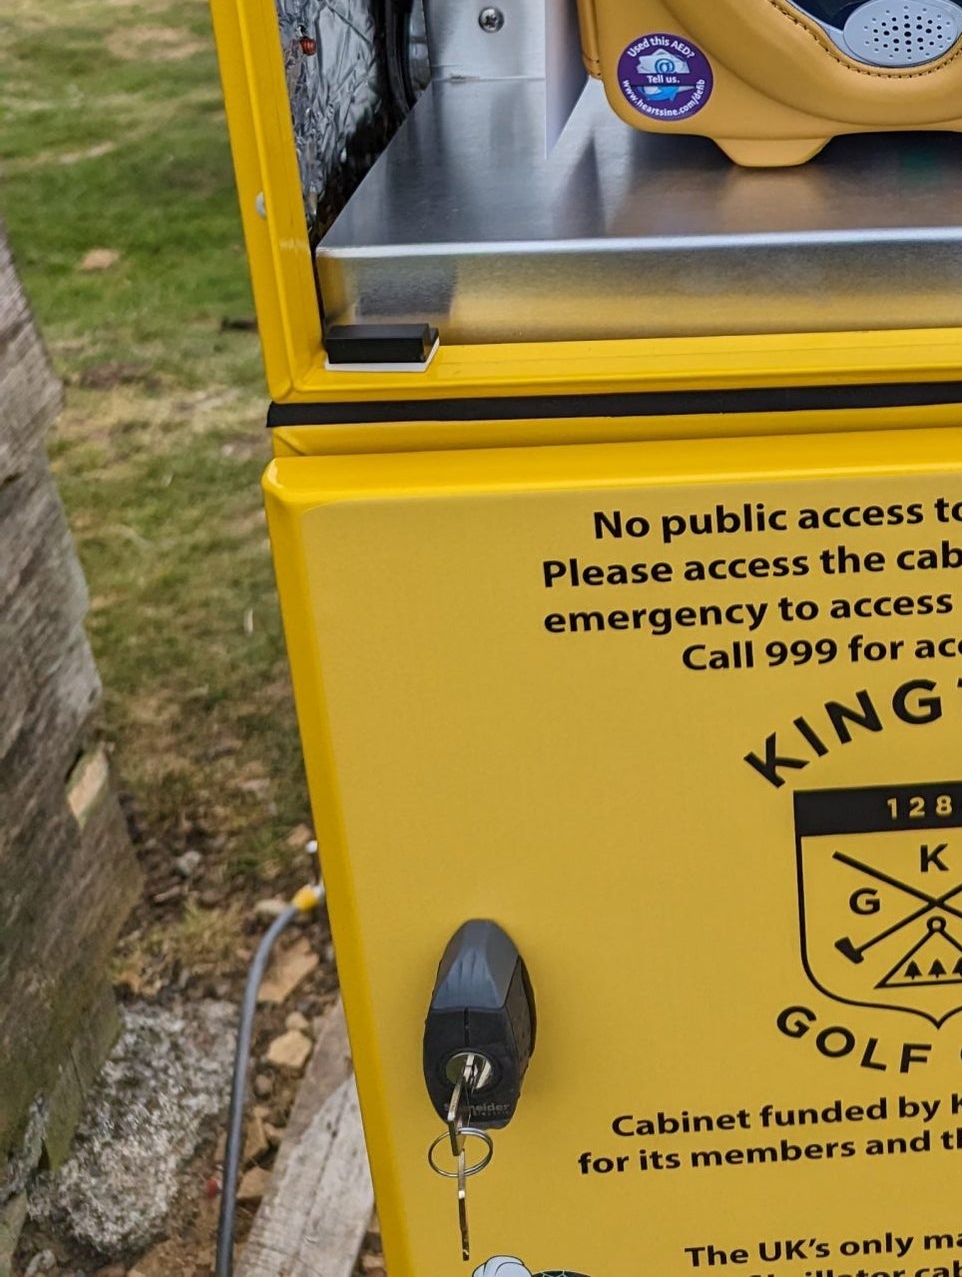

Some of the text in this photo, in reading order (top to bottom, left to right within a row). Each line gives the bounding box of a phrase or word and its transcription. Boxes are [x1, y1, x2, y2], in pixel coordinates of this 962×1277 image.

[627, 36, 696, 59] Used this AED?
[622, 78, 706, 117] www.heartsine.com/defib
[646, 74, 664, 84] Tell
[593, 510, 650, 540] No
[661, 503, 788, 544] public
[798, 503, 924, 530] access
[542, 558, 673, 588] Please
[683, 555, 810, 582] access
[819, 545, 886, 575] the
[544, 602, 769, 636] emergency
[777, 596, 819, 622] to
[830, 593, 953, 619] access
[682, 640, 754, 671] Call
[765, 638, 838, 667] 999
[847, 634, 905, 663] for
[920, 843, 949, 873] K
[849, 887, 881, 916] G
[776, 1005, 932, 1074] GOLF
[443, 1103, 511, 1112] Sneider
[611, 1109, 751, 1137] Cabinet
[759, 1096, 888, 1128] funded
[898, 1095, 941, 1123] by
[577, 1151, 630, 1175] for
[639, 1149, 681, 1171] its
[691, 1139, 856, 1168] members
[865, 1129, 931, 1156] and
[684, 1244, 749, 1267] The
[839, 1232, 914, 1258] only
